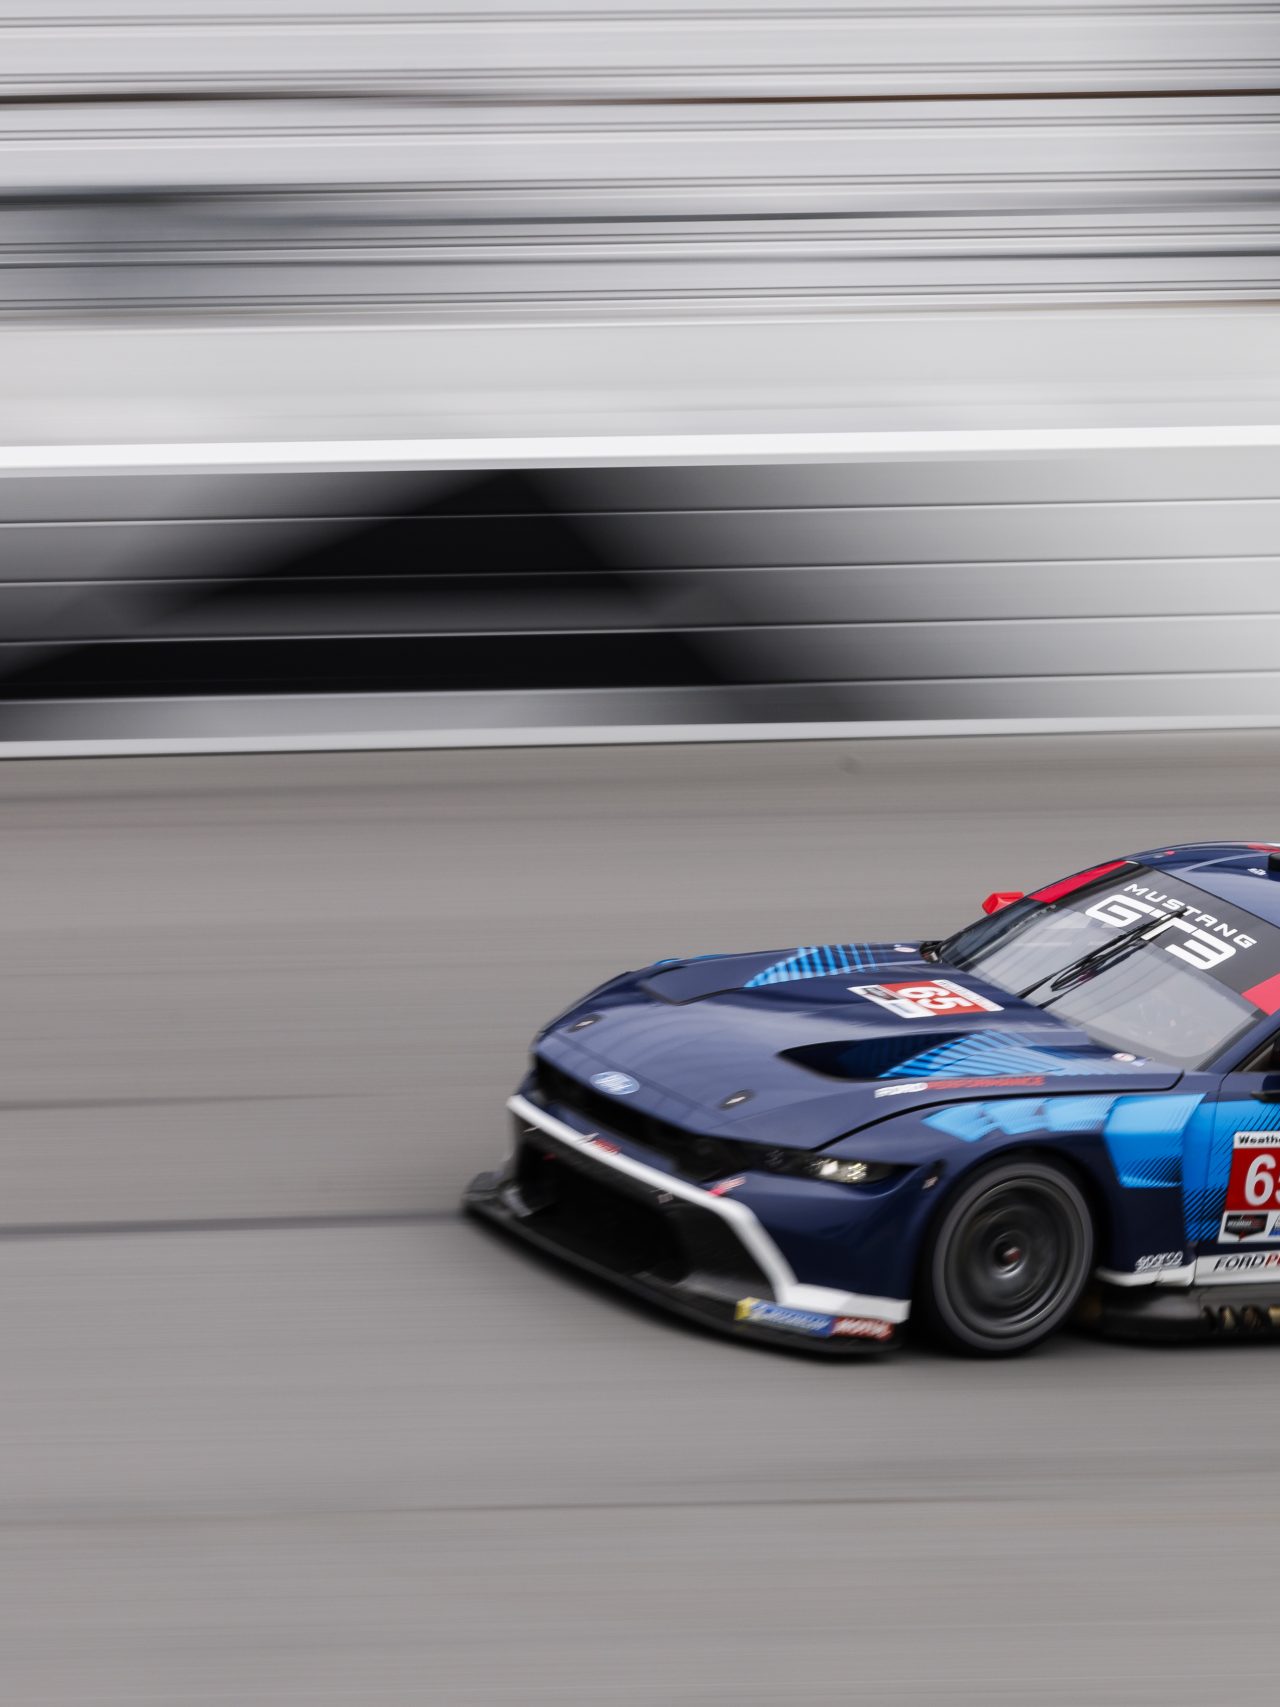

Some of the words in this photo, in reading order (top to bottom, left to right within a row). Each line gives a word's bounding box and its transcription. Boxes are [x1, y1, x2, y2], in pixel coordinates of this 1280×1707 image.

[1084, 894, 1237, 970] GT3
[1123, 883, 1258, 949] MUSTANG
[896, 986, 977, 1011] 65
